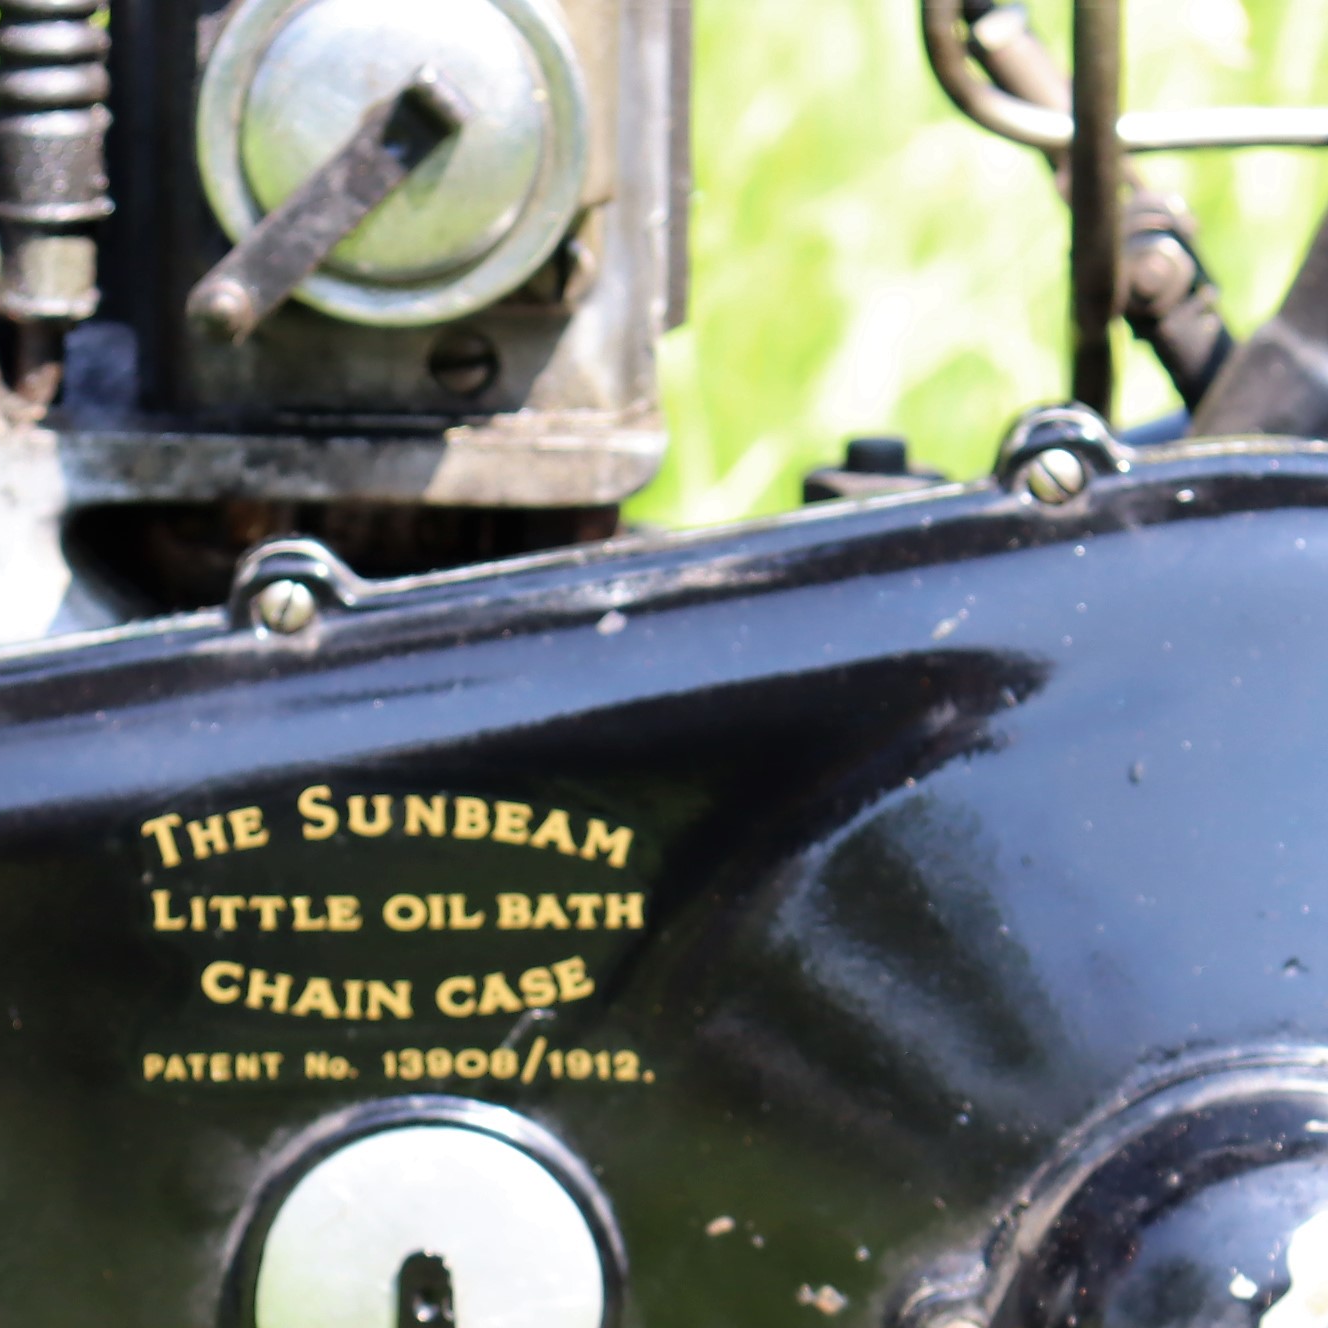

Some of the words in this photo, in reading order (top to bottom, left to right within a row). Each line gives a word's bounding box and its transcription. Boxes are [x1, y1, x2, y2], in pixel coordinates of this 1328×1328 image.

[141, 806, 270, 868] THE
[297, 785, 634, 869] SUNBEAM
[151, 889, 363, 932] LITTLE
[382, 893, 486, 932] OIL
[496, 892, 644, 930] BATH
[200, 961, 413, 1021] CHAIN
[435, 956, 595, 1018] CASE
[142, 1052, 284, 1082] PATENT
[304, 1052, 359, 1080] No.
